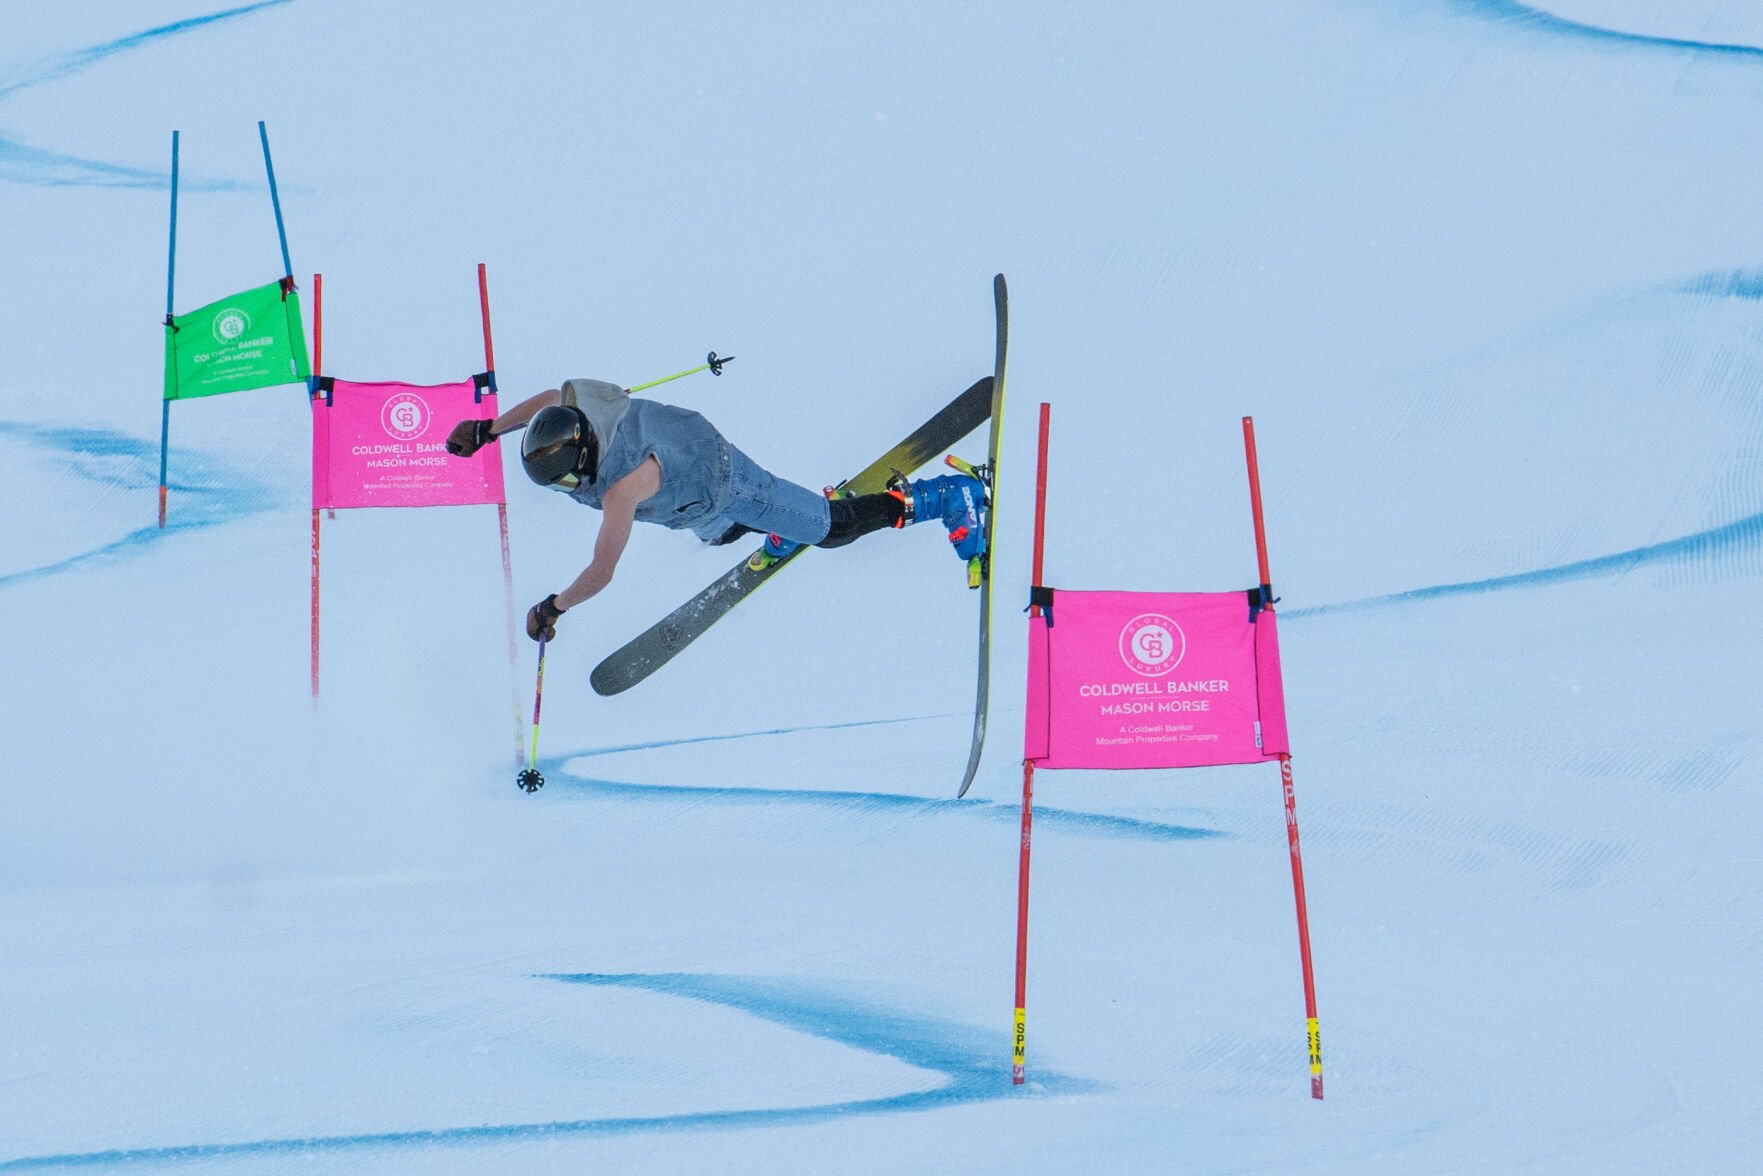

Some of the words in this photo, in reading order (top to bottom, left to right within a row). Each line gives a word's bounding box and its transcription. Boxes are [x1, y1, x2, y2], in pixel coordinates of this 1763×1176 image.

[352, 444, 413, 456] COLDWELL
[416, 443, 448, 453] BANK
[367, 458, 407, 468] MASON
[409, 457, 448, 467] MORSE
[1079, 682, 1163, 697] COLDWELL
[1167, 680, 1229, 694] BANKER
[1101, 702, 1154, 715] MASON
[1158, 700, 1210, 713] MORSE
[1127, 724, 1163, 733] Coldwell
[1165, 723, 1194, 732] Banker
[1096, 736, 1134, 745] Mountain
[1135, 734, 1178, 744] Properties
[1179, 733, 1219, 742] Company
[1014, 1022, 1025, 1057] SPM
